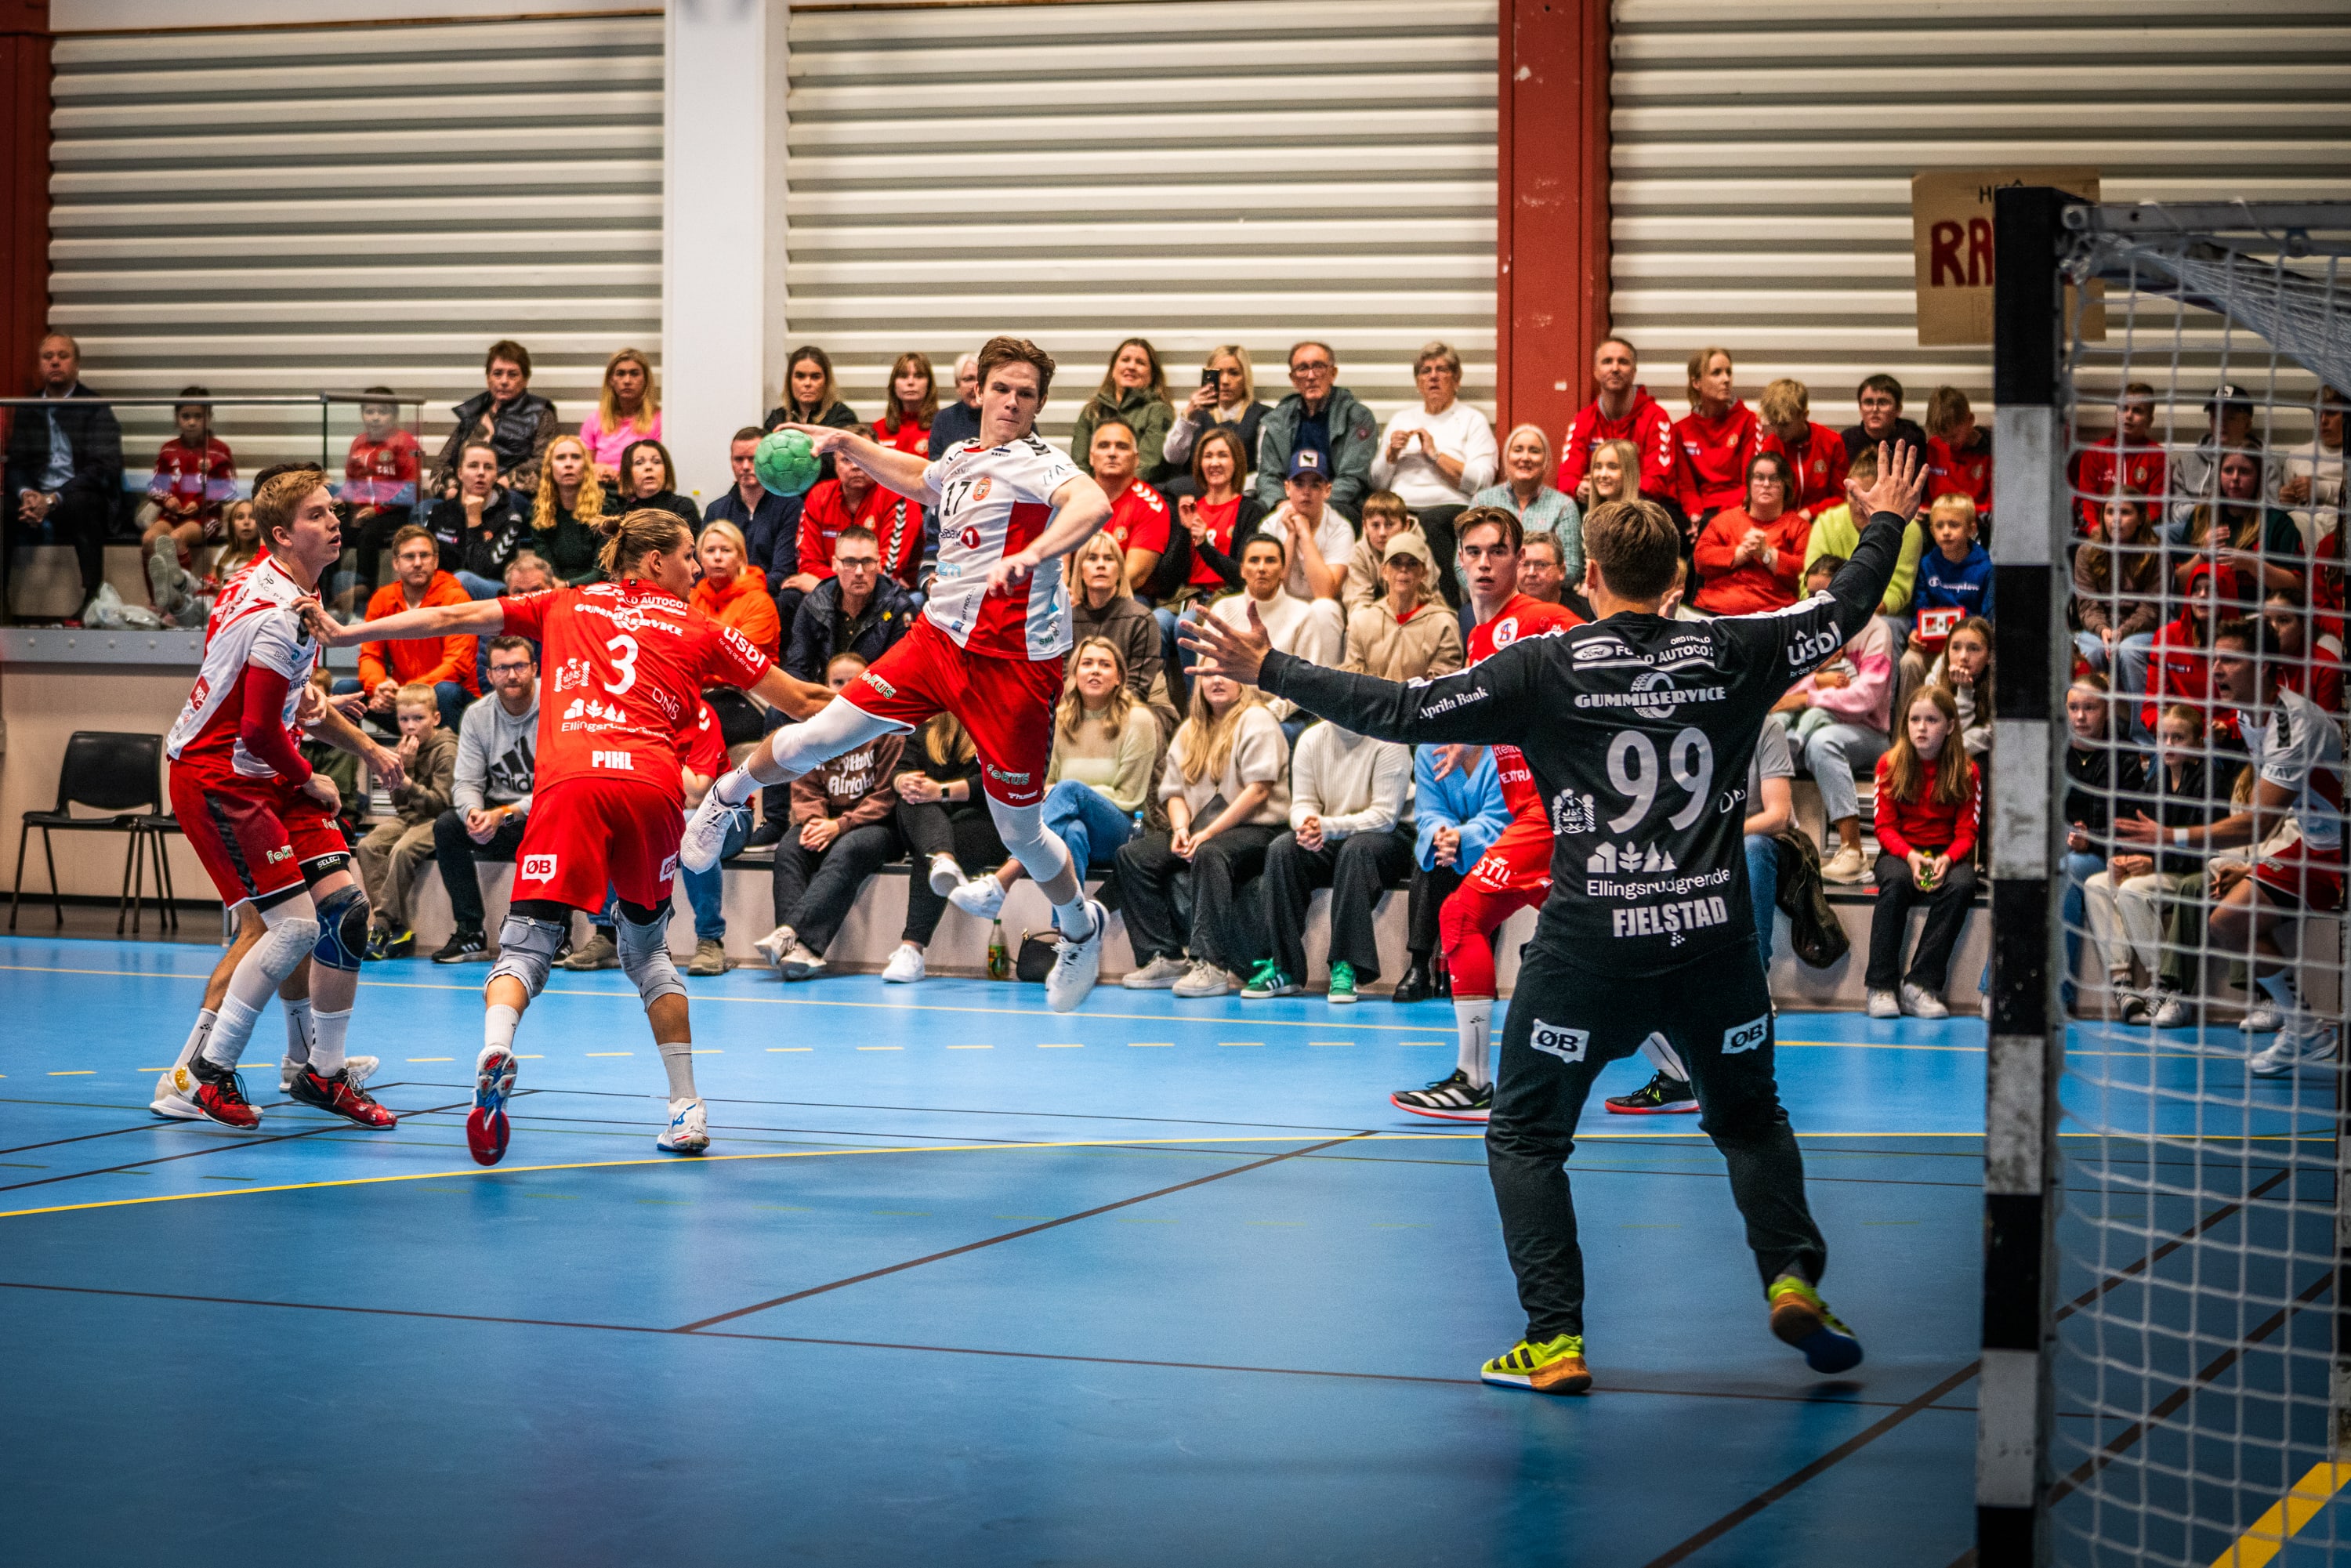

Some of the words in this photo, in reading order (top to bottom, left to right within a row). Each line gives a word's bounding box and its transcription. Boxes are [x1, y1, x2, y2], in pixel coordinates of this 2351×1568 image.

[944, 481, 972, 516] 17
[640, 596, 684, 609] AUTOCO
[603, 635, 639, 695] 3
[1658, 644, 1709, 663] AUTOCO
[653, 686, 680, 720] DNB
[1419, 697, 1458, 719] Aprila
[1455, 686, 1489, 706] Bank
[1574, 686, 1726, 708] GUMMISERVICE
[592, 750, 635, 771] PIHL
[1607, 726, 1714, 834] 99
[525, 860, 552, 875] ØB
[1586, 867, 1731, 900] Ellingsrudgrenda
[1611, 896, 1729, 938] FJELSTAD
[1536, 1030, 1579, 1053] ØB
[1730, 1023, 1764, 1048] ØB
